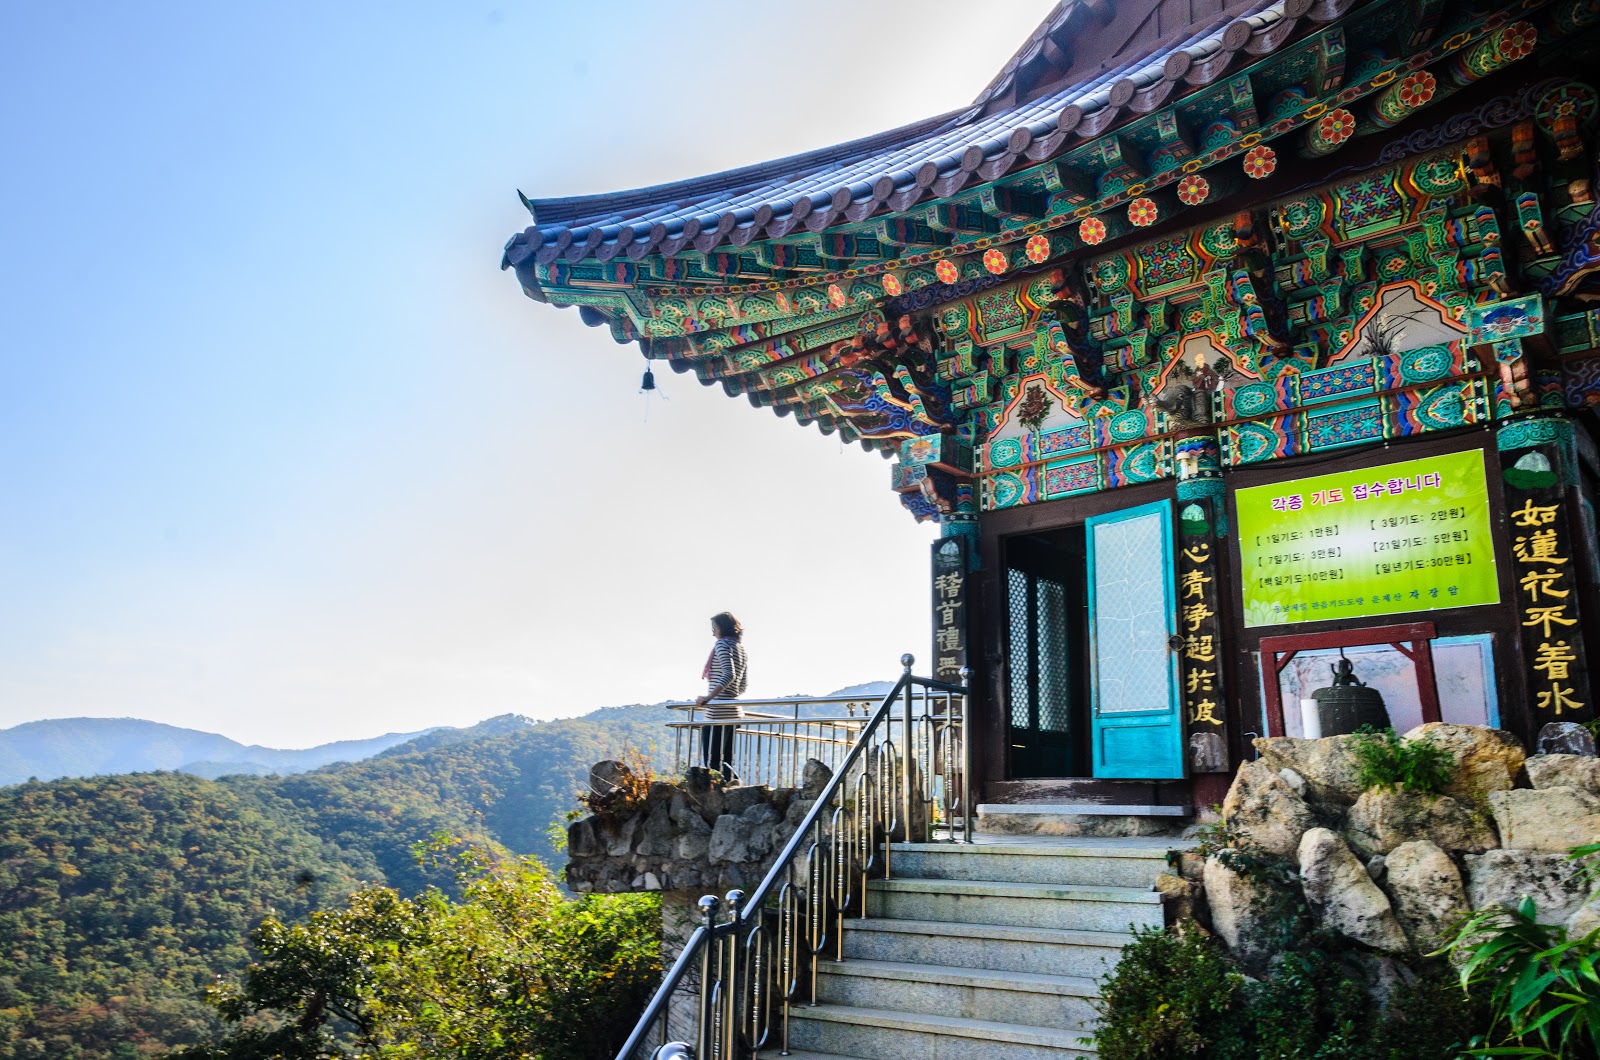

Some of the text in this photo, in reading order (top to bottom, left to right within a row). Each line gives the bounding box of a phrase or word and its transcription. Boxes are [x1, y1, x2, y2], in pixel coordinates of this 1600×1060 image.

[1272, 472, 1441, 512] 각종 기도 접수합니다
